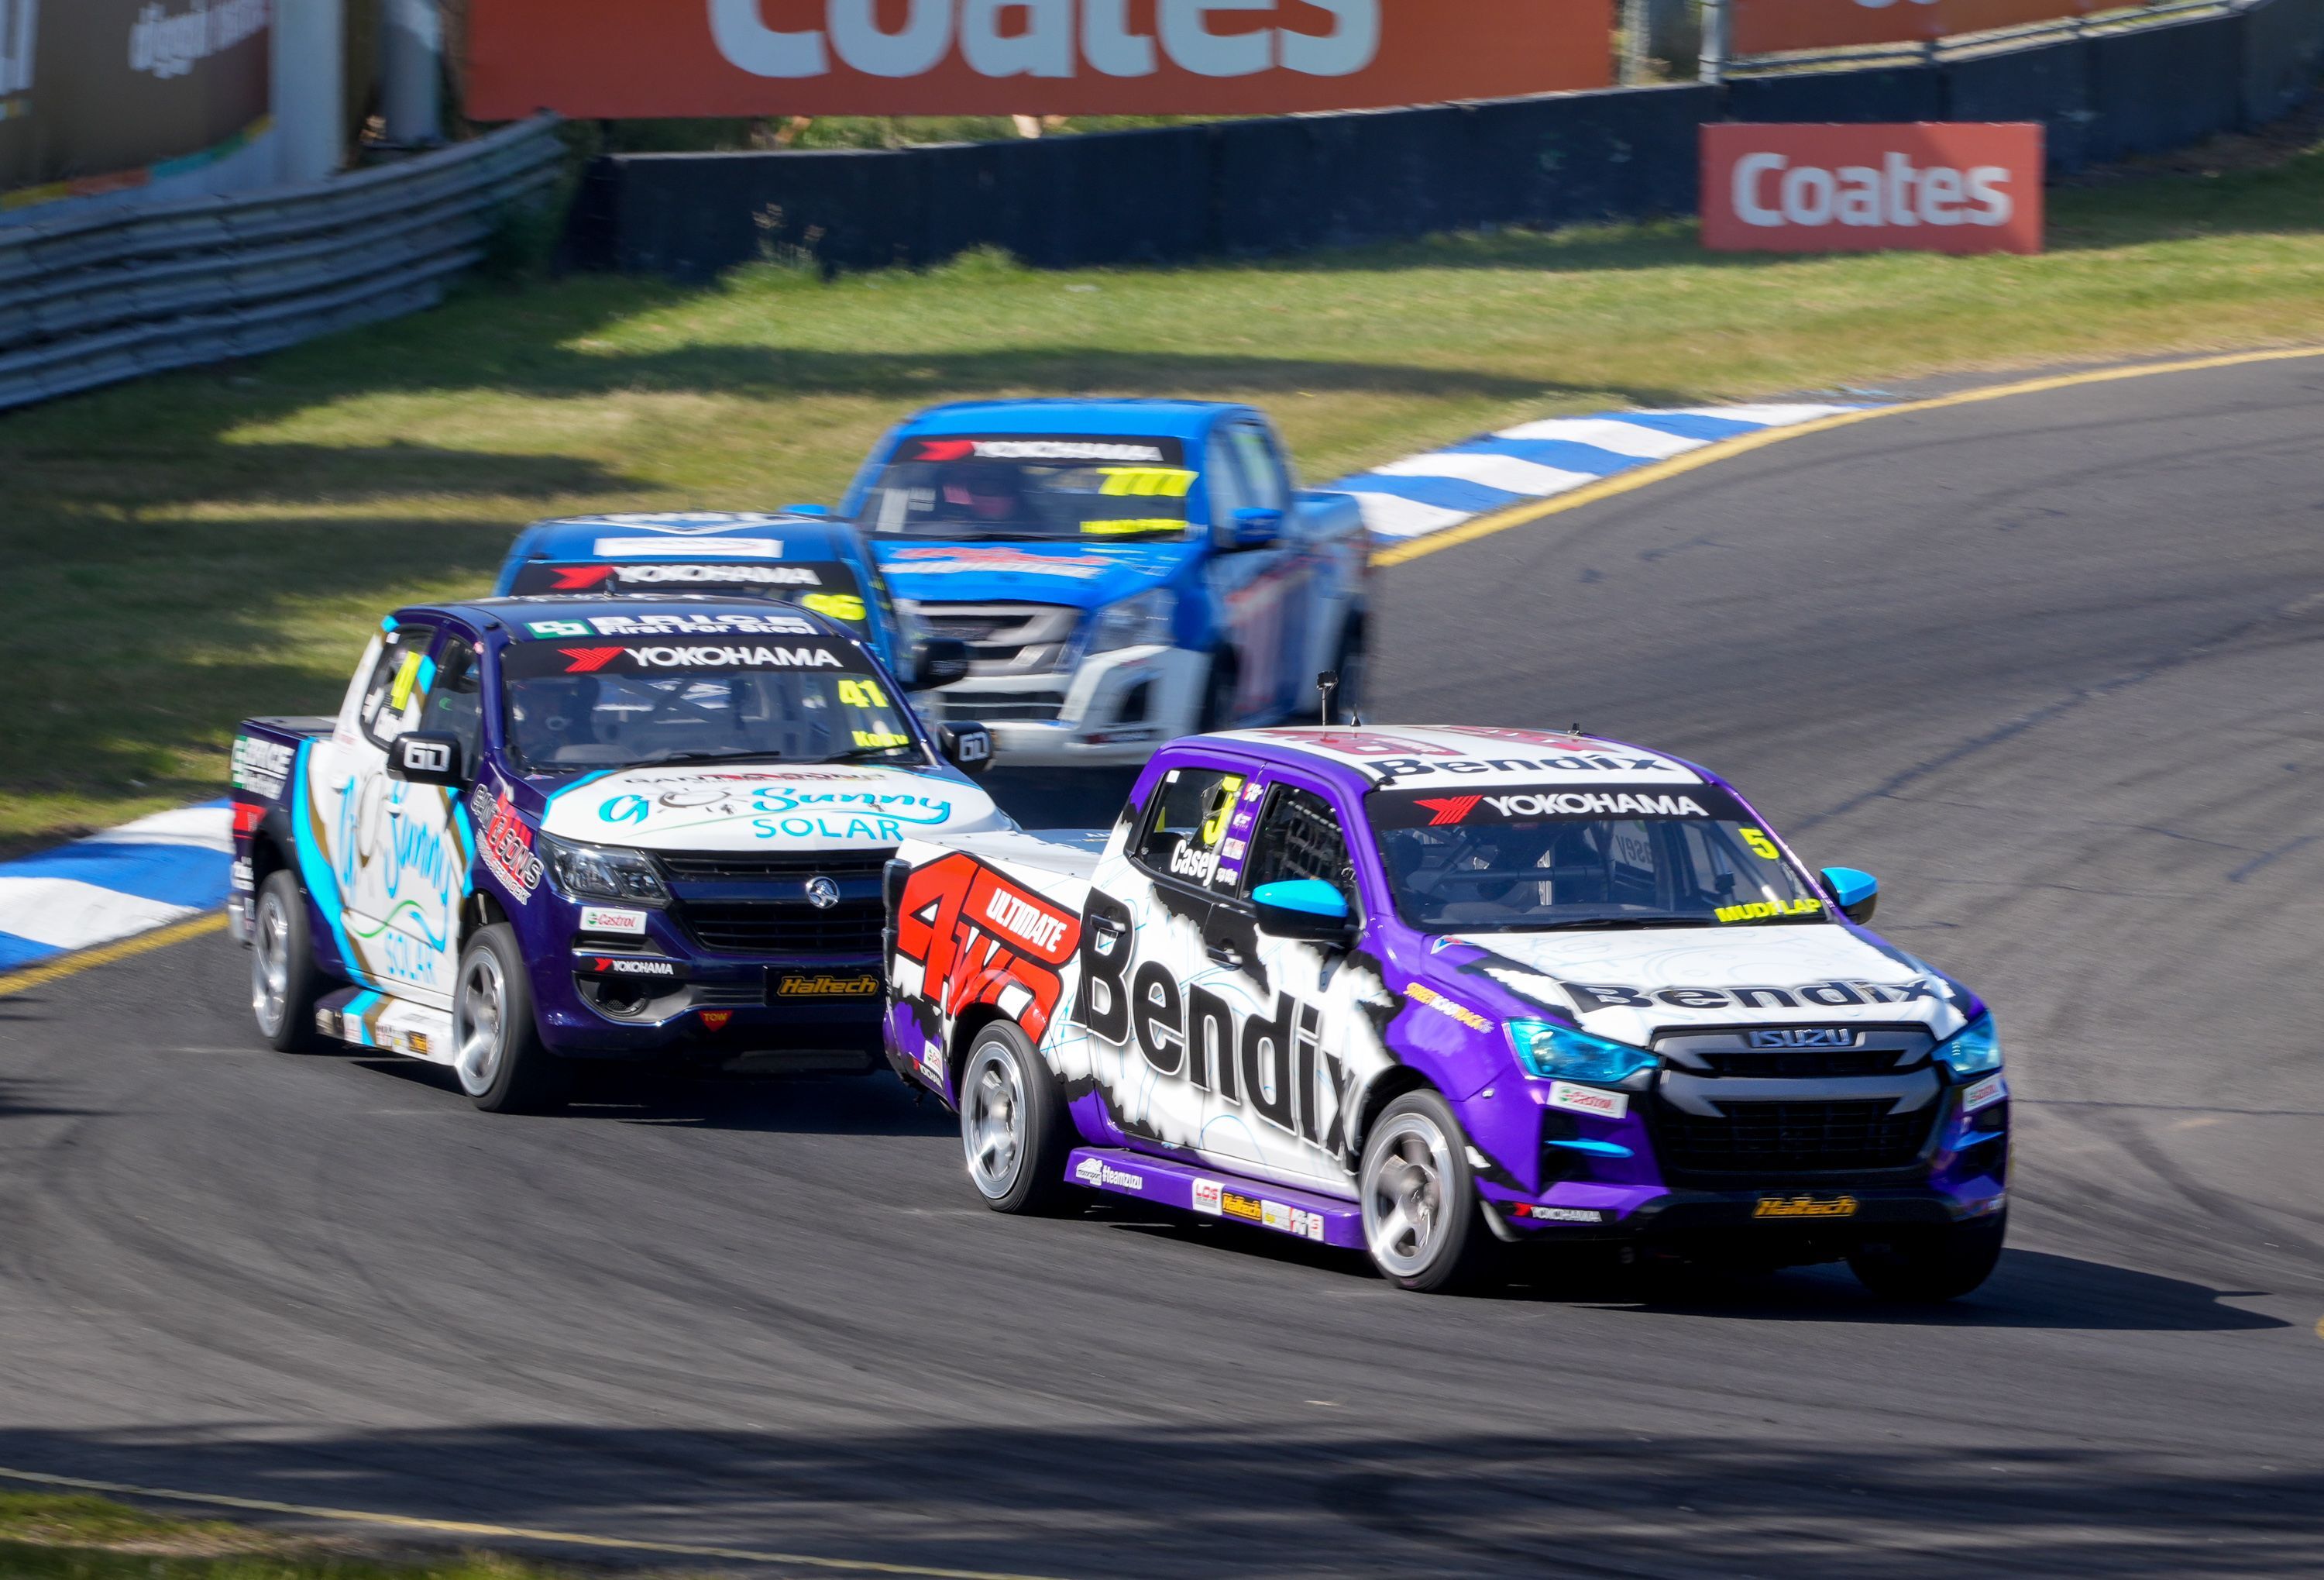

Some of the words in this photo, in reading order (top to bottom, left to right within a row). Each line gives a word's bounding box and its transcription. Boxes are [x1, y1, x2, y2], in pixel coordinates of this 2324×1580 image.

[1731, 151, 2011, 227] Coates
[678, 624, 731, 634] For
[624, 646, 844, 667] YOKOHAMA
[837, 680, 889, 707] 41
[1363, 755, 1675, 777] Bendix
[752, 787, 951, 824] Sunny
[1483, 793, 1710, 817] YOKOHAMA
[755, 818, 904, 842] SOLAR
[1738, 828, 1780, 860] 5
[1171, 839, 1221, 886] Casey
[598, 913, 634, 928] Castrol
[986, 888, 1067, 953] ULTIMATE
[1714, 898, 1823, 923] MUDFLAP
[613, 961, 674, 975] YOKOHAMA
[776, 975, 879, 997] Haltech
[1556, 978, 1946, 1015] Bendix
[703, 1013, 728, 1021] TOW
[1070, 886, 1359, 1177] Bendix
[1748, 1028, 1851, 1046] ISUZU
[1102, 1165, 1143, 1189] #teamzuzu
[1222, 1193, 1261, 1220] Haltech
